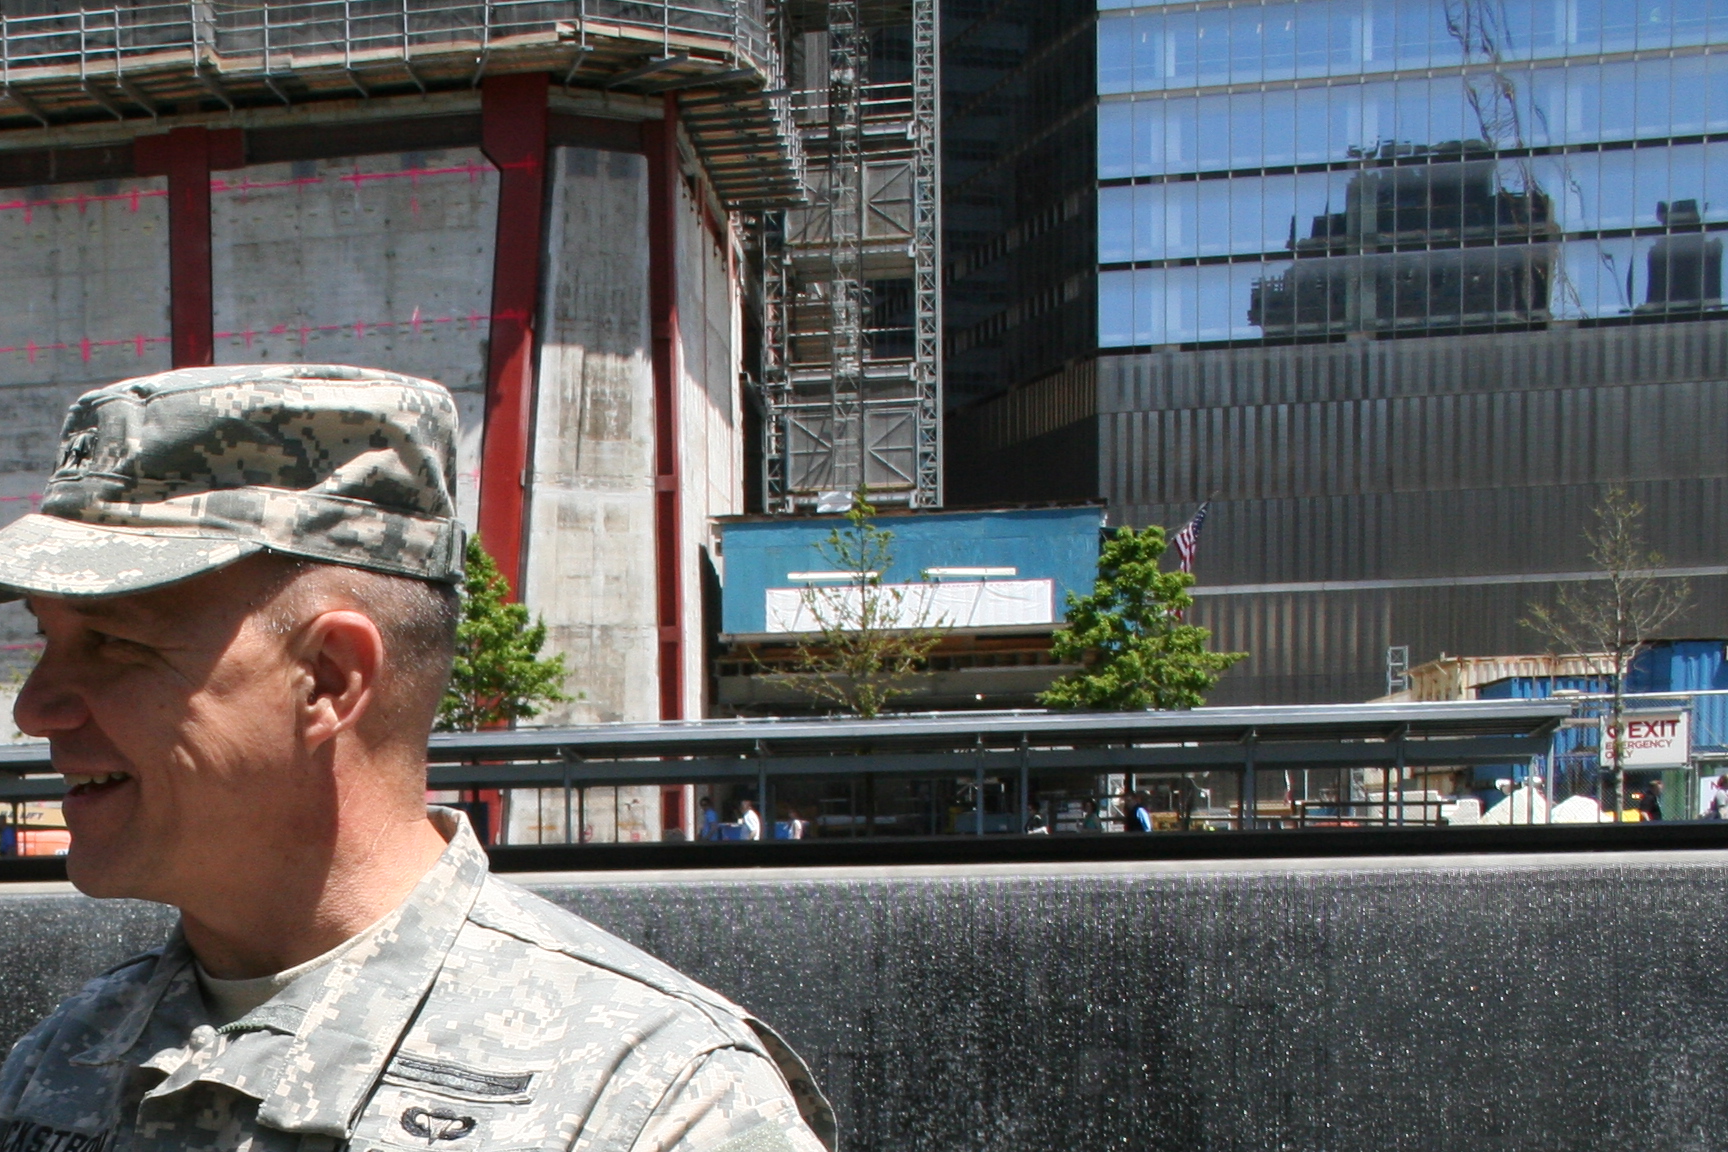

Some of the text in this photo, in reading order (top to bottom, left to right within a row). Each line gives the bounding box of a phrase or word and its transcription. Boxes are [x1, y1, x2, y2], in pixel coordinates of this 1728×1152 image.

[1628, 719, 1680, 739] EXIT
[1605, 739, 1673, 750] EERGENCY
[1605, 750, 1633, 759] OLY
